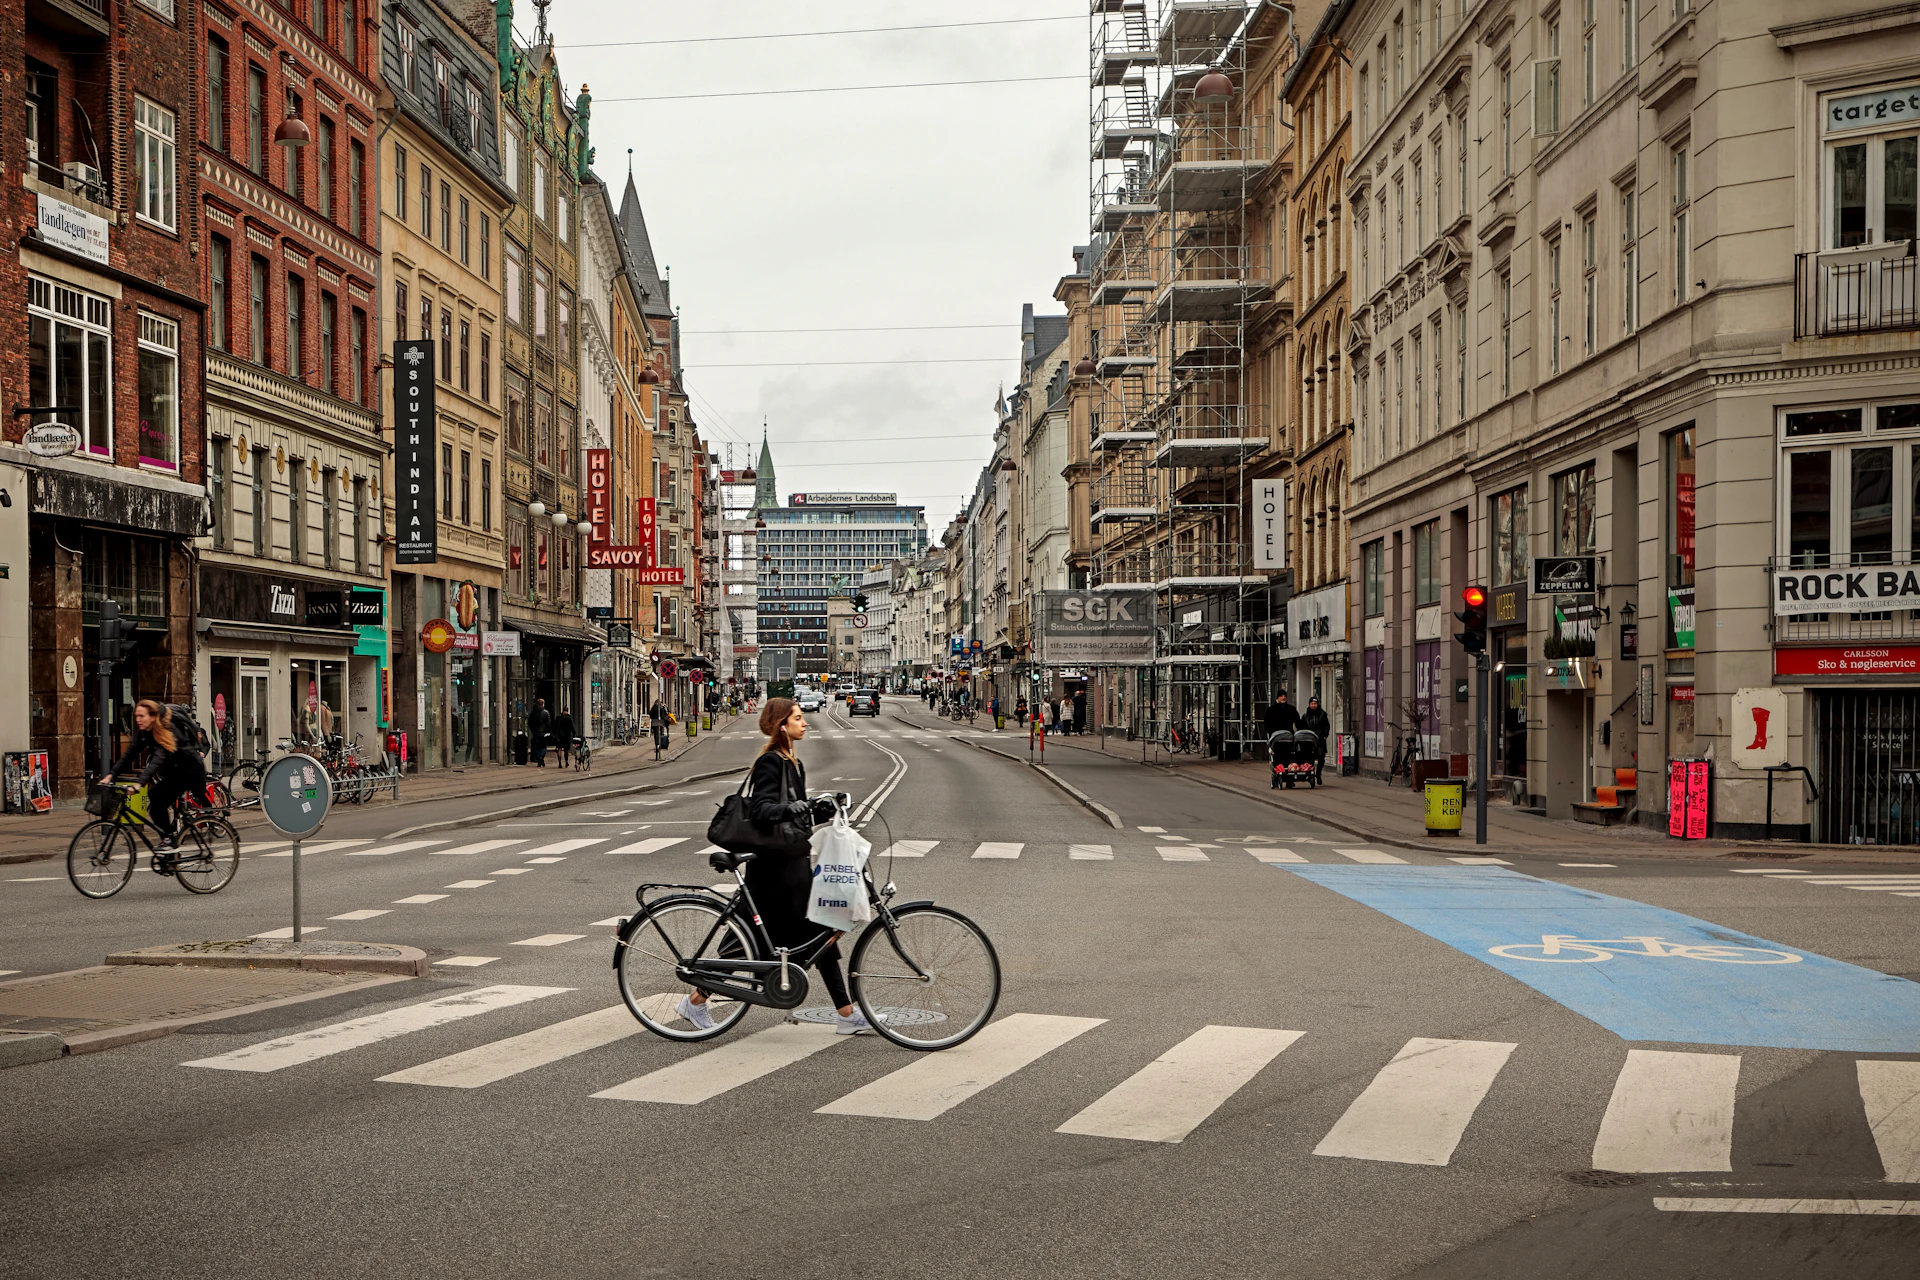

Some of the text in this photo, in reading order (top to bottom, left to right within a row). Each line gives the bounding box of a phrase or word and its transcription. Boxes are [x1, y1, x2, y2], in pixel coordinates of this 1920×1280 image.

[1832, 94, 1919, 121] target
[39, 205, 86, 241] Tandlægen
[26, 433, 77, 445] Tandlægen
[591, 453, 605, 542] HOTEL
[807, 493, 896, 504] Arbejdernes Landsbank
[1263, 487, 1275, 561] HOTEL
[591, 550, 643, 565] SAVOY
[641, 570, 683, 583] HOTEL
[1540, 582, 1581, 591] ZEPPELIN
[1779, 572, 1869, 601] ROCK
[271, 584, 296, 615] Zizzi
[351, 602, 380, 614] Zizzi
[1063, 597, 1133, 622] SGK
[1843, 649, 1889, 658] CARLSSON
[1817, 658, 1916, 671] Sko & nøgleservice
[1442, 798, 1460, 806] REN
[1442, 808, 1460, 816] KBH
[824, 864, 837, 873] EN
[817, 897, 848, 908] Irma
